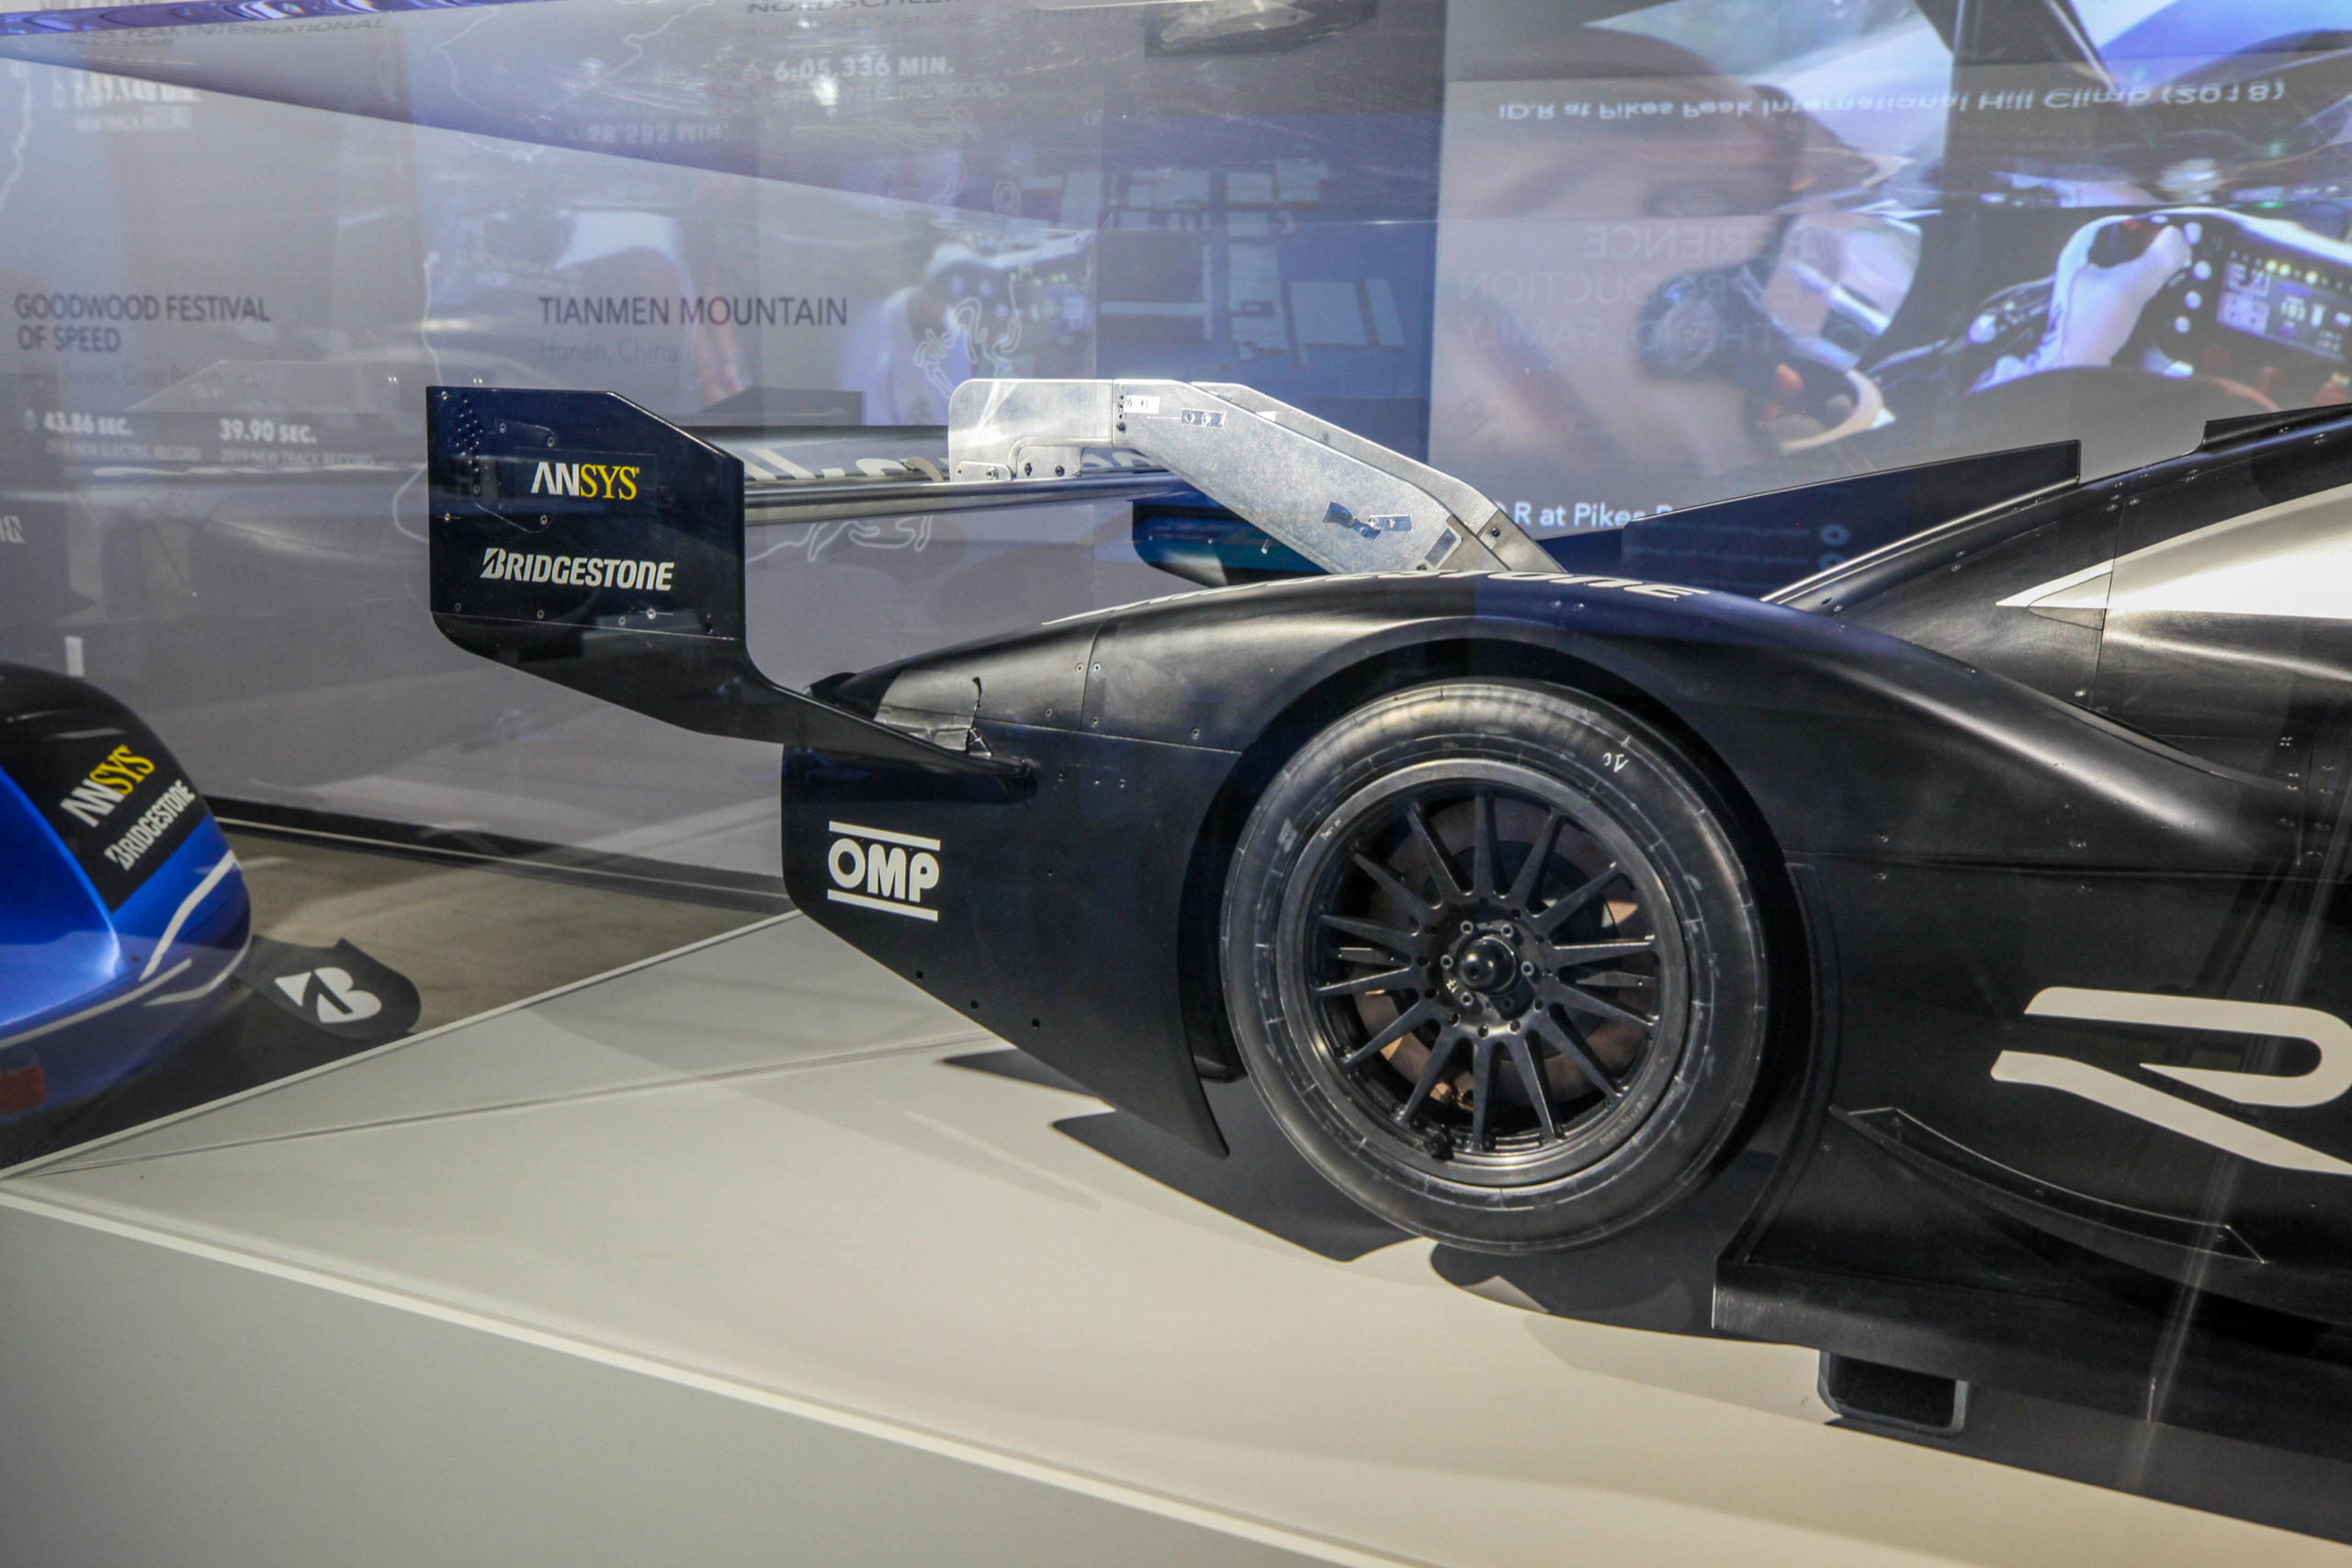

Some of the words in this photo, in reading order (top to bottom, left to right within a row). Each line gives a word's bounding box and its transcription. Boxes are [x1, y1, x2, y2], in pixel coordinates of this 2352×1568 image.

[898, 55, 956, 76] MIN.
[15, 293, 160, 321] GOODWOOD
[165, 295, 271, 322] FESTIVAL
[537, 296, 670, 325] TIANMEN
[680, 296, 848, 327] MOUNTAIN
[17, 325, 48, 352] OF
[52, 324, 121, 353] SPEED
[617, 337, 679, 364] China
[219, 418, 275, 443] 39.90
[278, 423, 319, 445] SEC.
[530, 461, 639, 501] ANSYS
[1539, 503, 1566, 528] at
[480, 547, 675, 592] BRIDGESTONE
[60, 743, 156, 829] ANSYS
[103, 779, 197, 872] BRIDGESTONE
[828, 837, 940, 902] OMP
